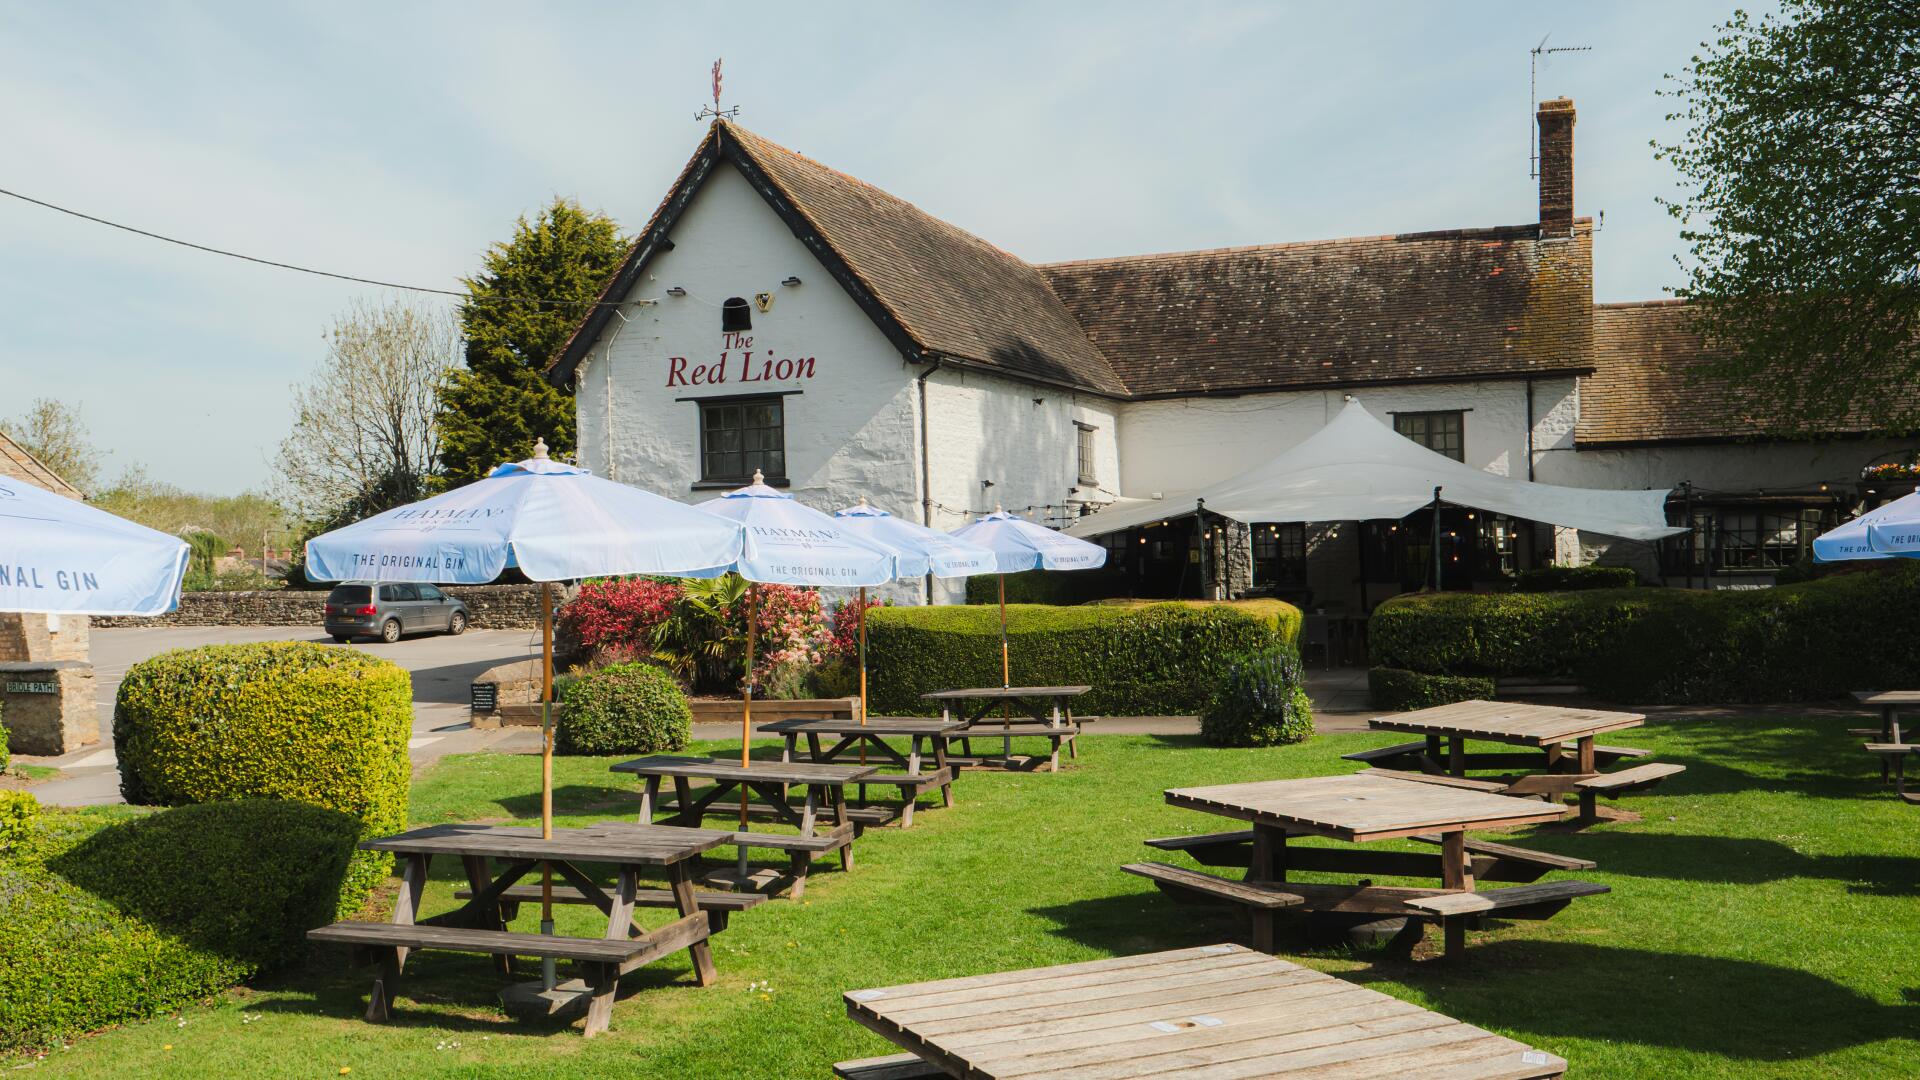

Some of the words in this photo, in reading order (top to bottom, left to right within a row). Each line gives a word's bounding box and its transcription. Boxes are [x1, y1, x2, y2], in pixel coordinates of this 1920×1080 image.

[733, 105, 740, 115] E
[694, 112, 704, 121] W
[722, 331, 754, 350] The
[665, 351, 728, 388] Red
[739, 349, 816, 383] Lion
[1890, 535, 1905, 545] THE
[353, 554, 376, 567] THE
[381, 554, 439, 569] ORIGINAL
[445, 557, 466, 569] GIN
[769, 565, 789, 575] THE
[791, 566, 837, 577] ORIGINAL
[841, 568, 858, 577] GIN
[56, 570, 100, 592] GIN
[33, 682, 53, 692] PATH
